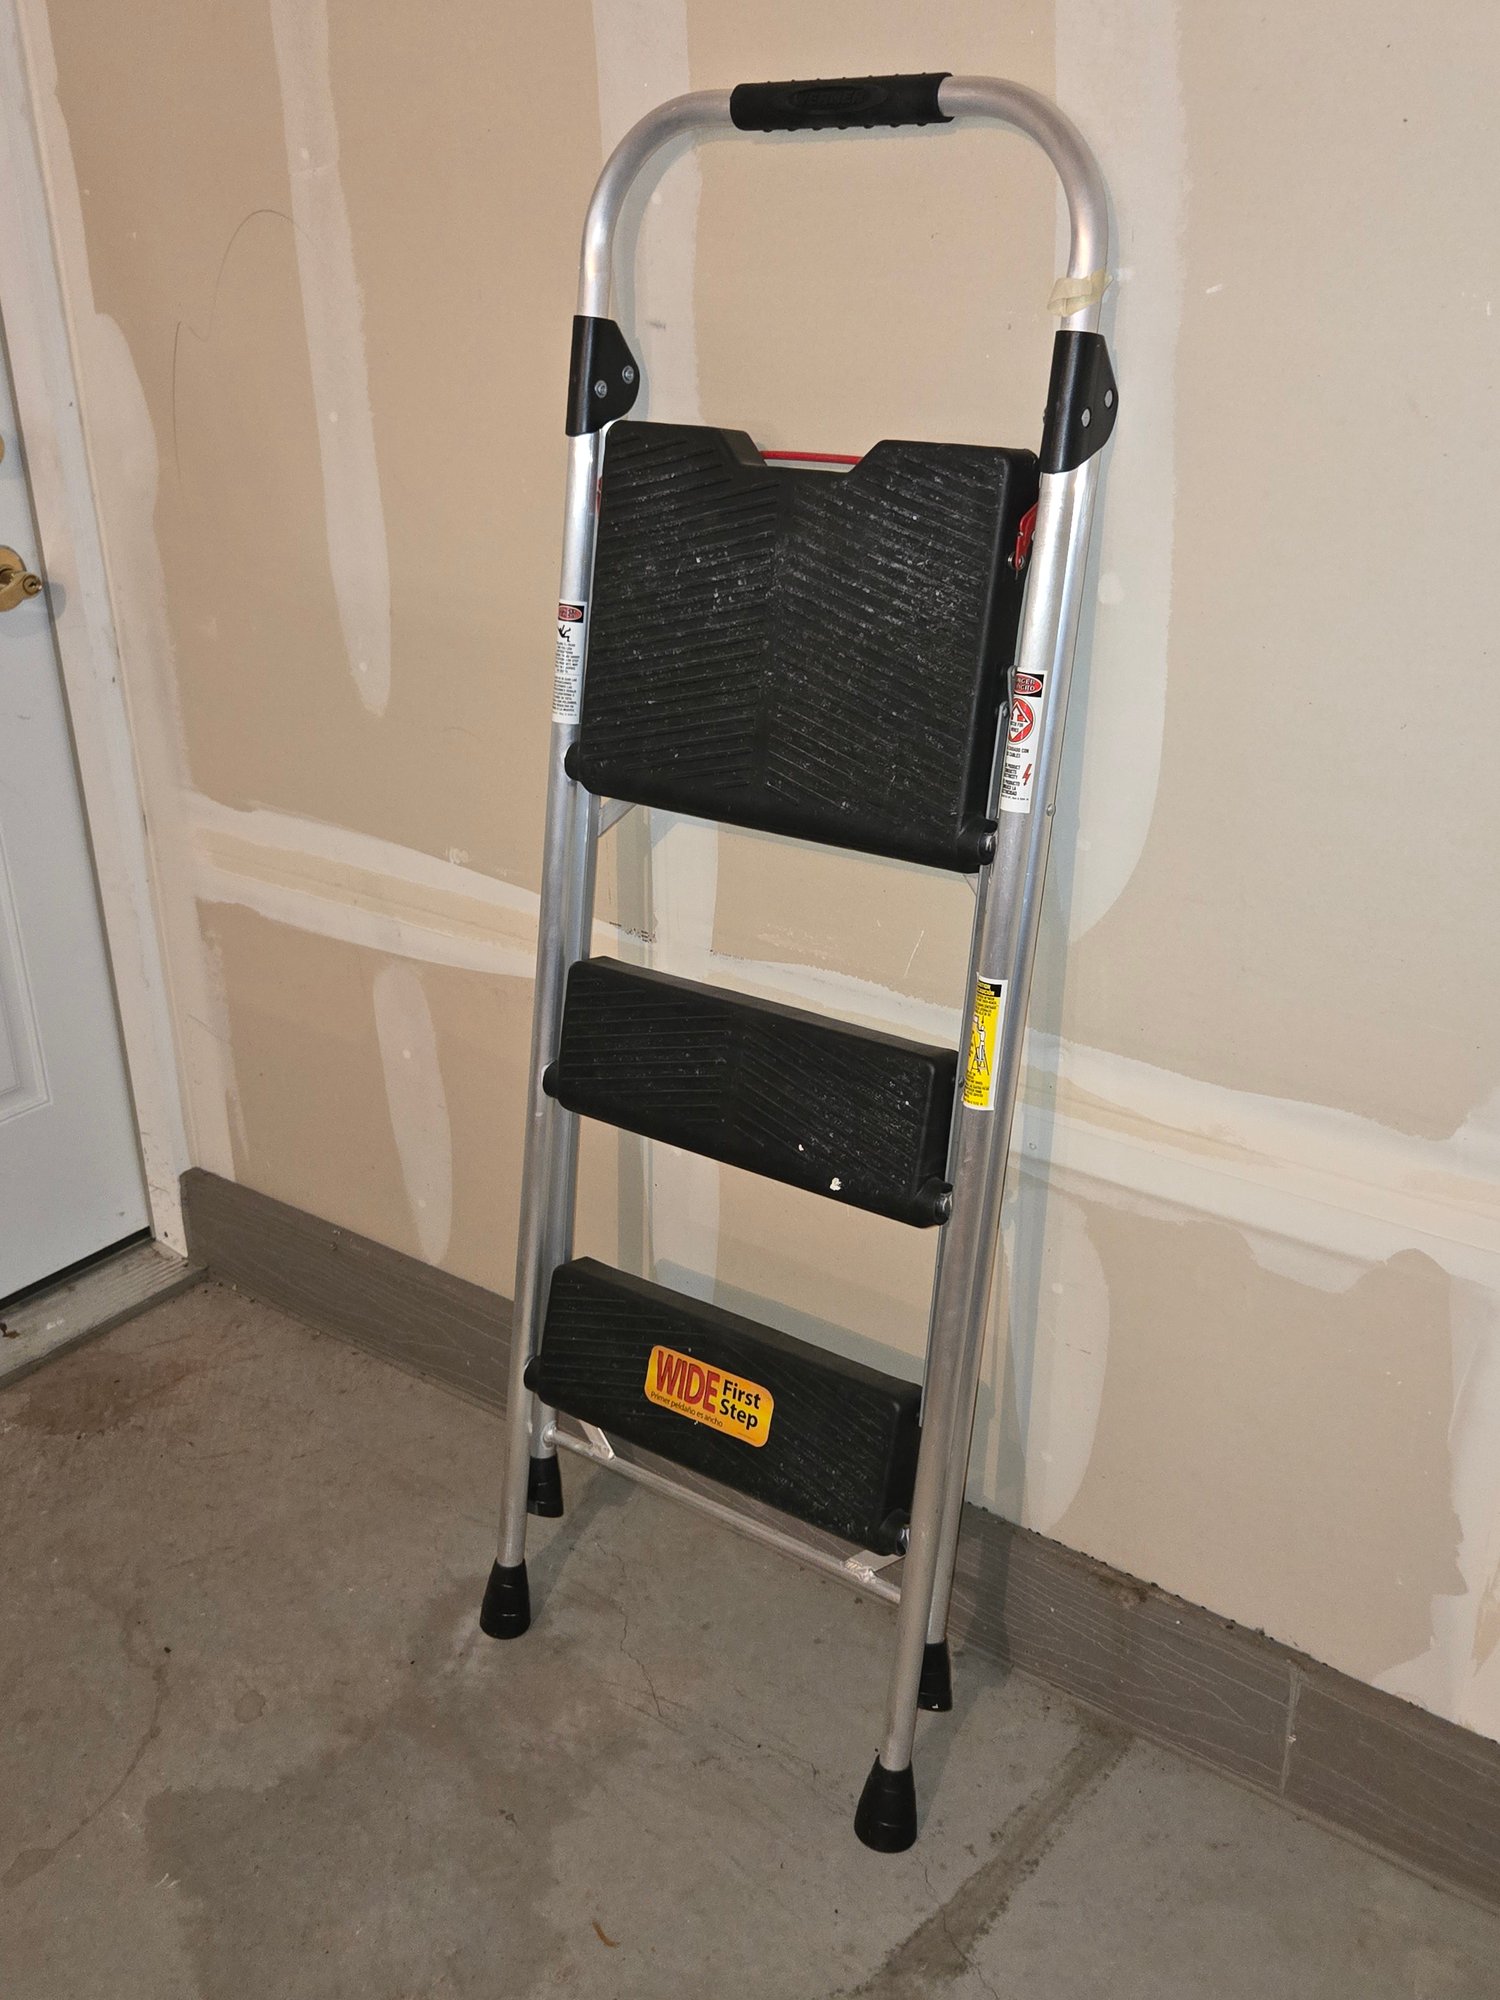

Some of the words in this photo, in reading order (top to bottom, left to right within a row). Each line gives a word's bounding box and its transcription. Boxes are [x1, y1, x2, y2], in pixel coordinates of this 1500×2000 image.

[656, 1350, 721, 1414] WIDE
[723, 1379, 761, 1410] First
[719, 1398, 758, 1431] Step
